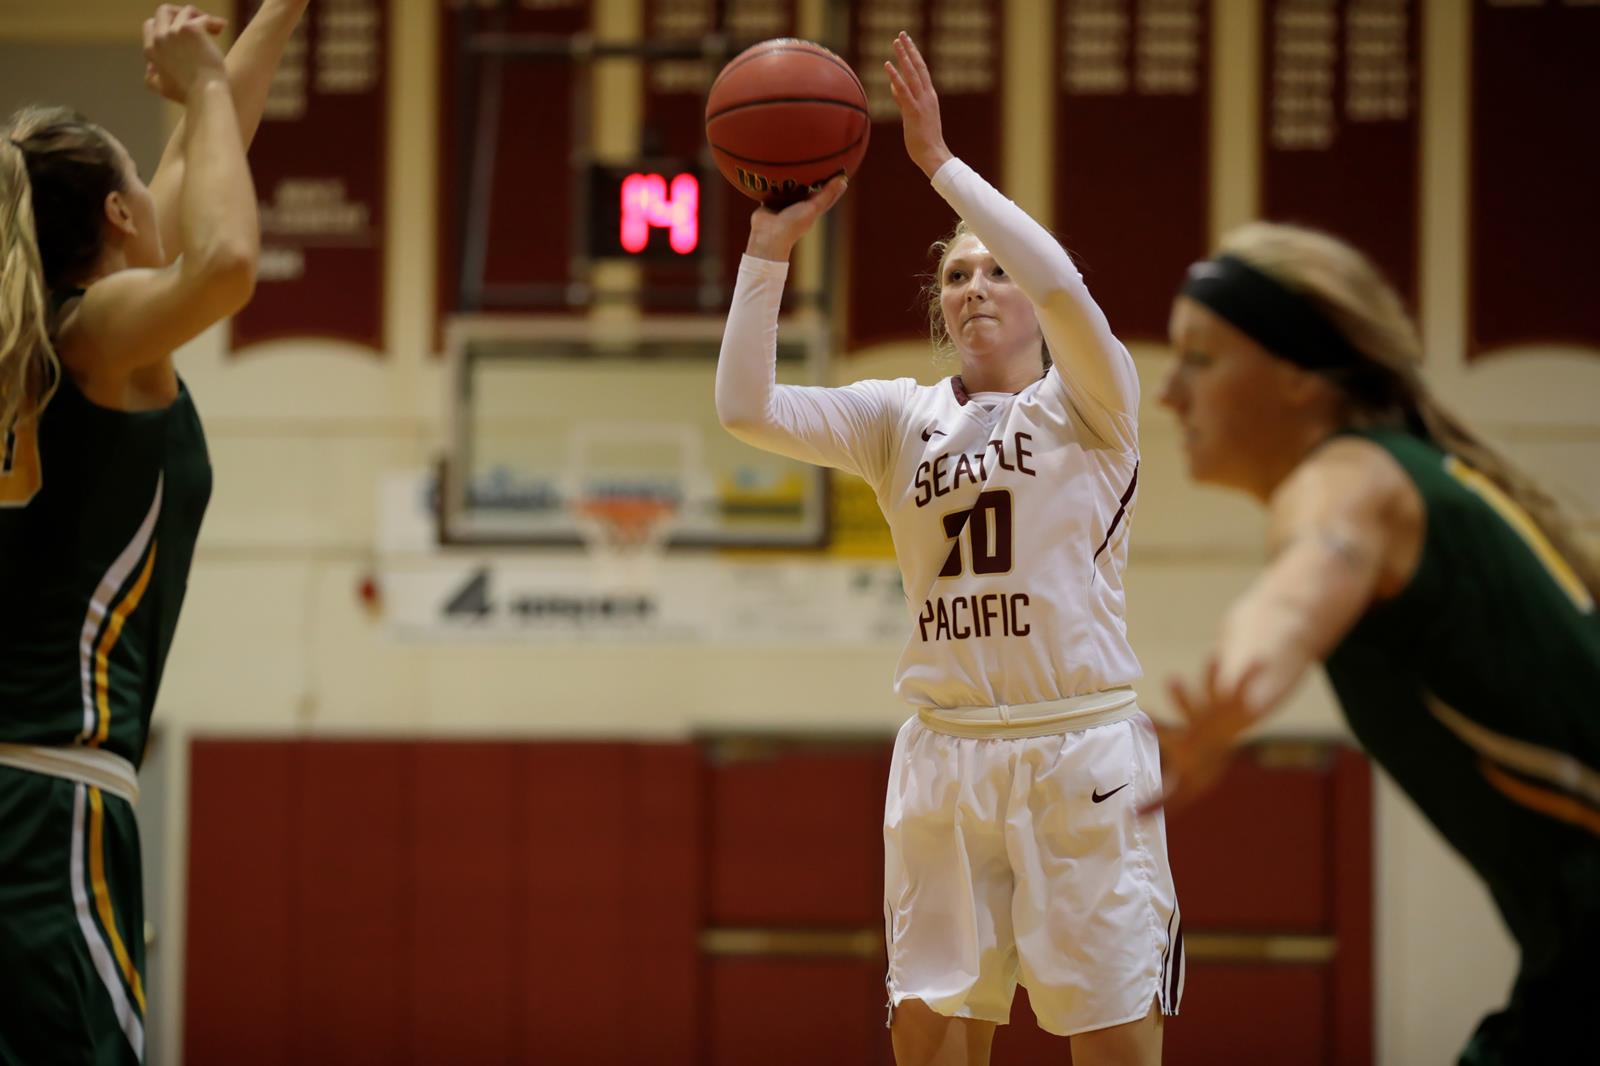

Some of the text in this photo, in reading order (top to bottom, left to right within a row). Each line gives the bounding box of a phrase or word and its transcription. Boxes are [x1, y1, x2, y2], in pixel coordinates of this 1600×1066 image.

[620, 172, 698, 254] 14
[915, 432, 1036, 507] SEATTLE
[919, 594, 1031, 642] PACIFIC
